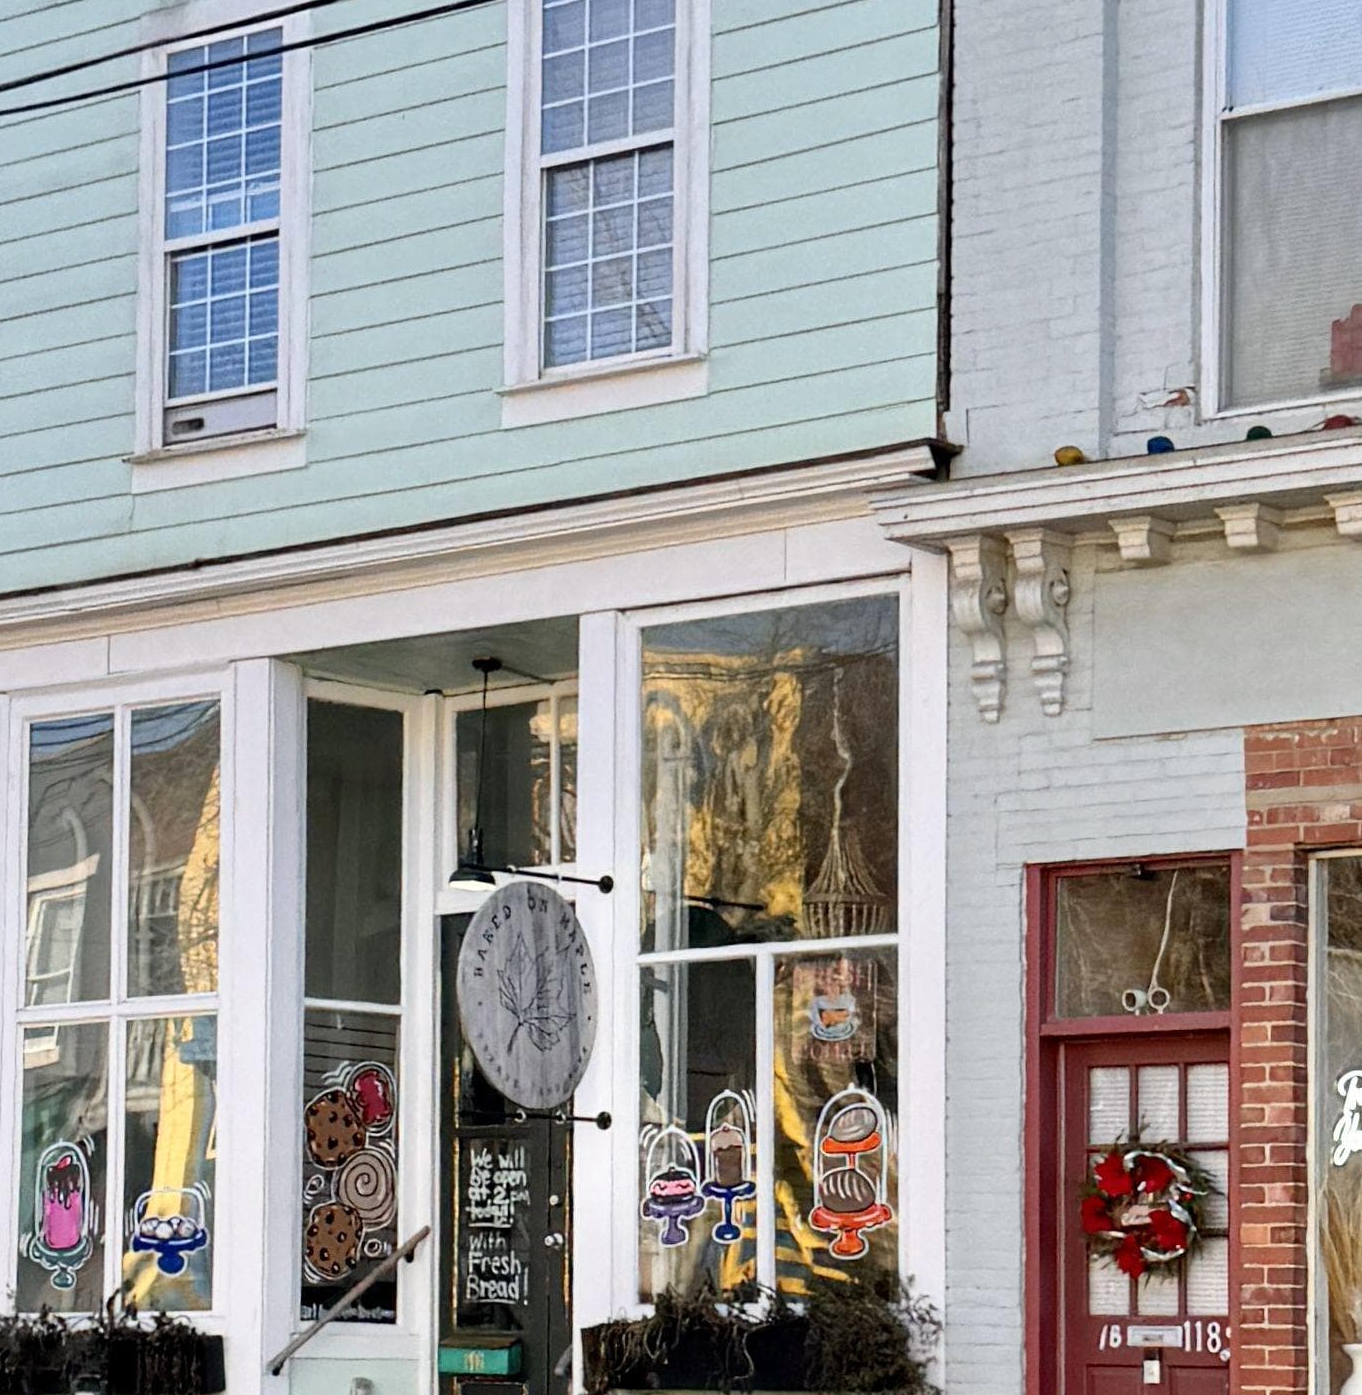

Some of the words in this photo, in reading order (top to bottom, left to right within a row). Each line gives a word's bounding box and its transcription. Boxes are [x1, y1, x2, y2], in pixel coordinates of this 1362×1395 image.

[470, 1148, 493, 1168] We
[498, 1146, 525, 1169] will
[493, 1170, 527, 1188] open
[468, 1186, 491, 1201] at
[493, 1186, 509, 1204] 2
[468, 1250, 521, 1275] Fresh
[1183, 1320, 1222, 1354] 118
